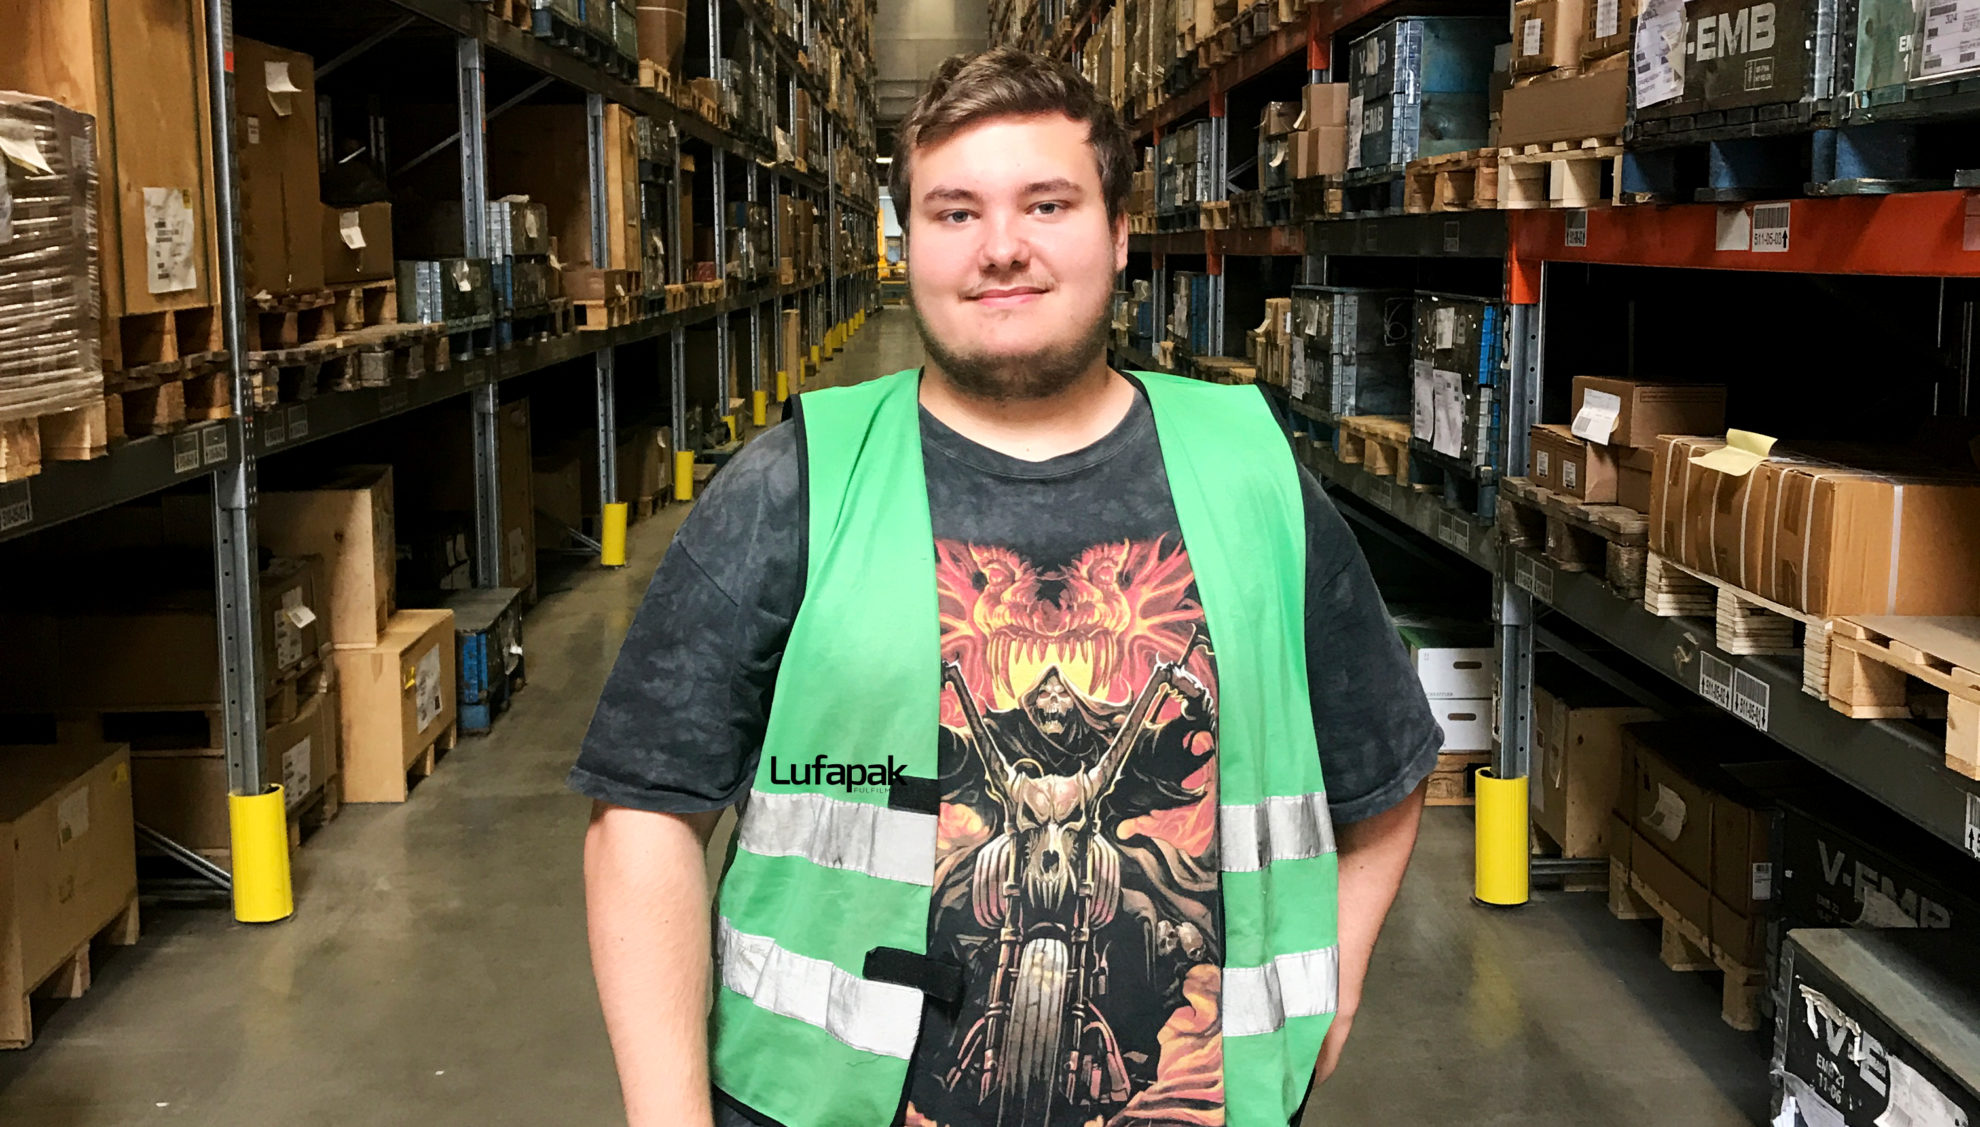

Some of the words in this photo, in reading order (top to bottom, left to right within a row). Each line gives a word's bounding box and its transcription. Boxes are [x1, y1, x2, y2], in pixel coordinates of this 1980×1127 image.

[1686, 2, 1776, 62] -EMB
[1364, 106, 1384, 135] EMB
[770, 754, 908, 793] Lufapak
